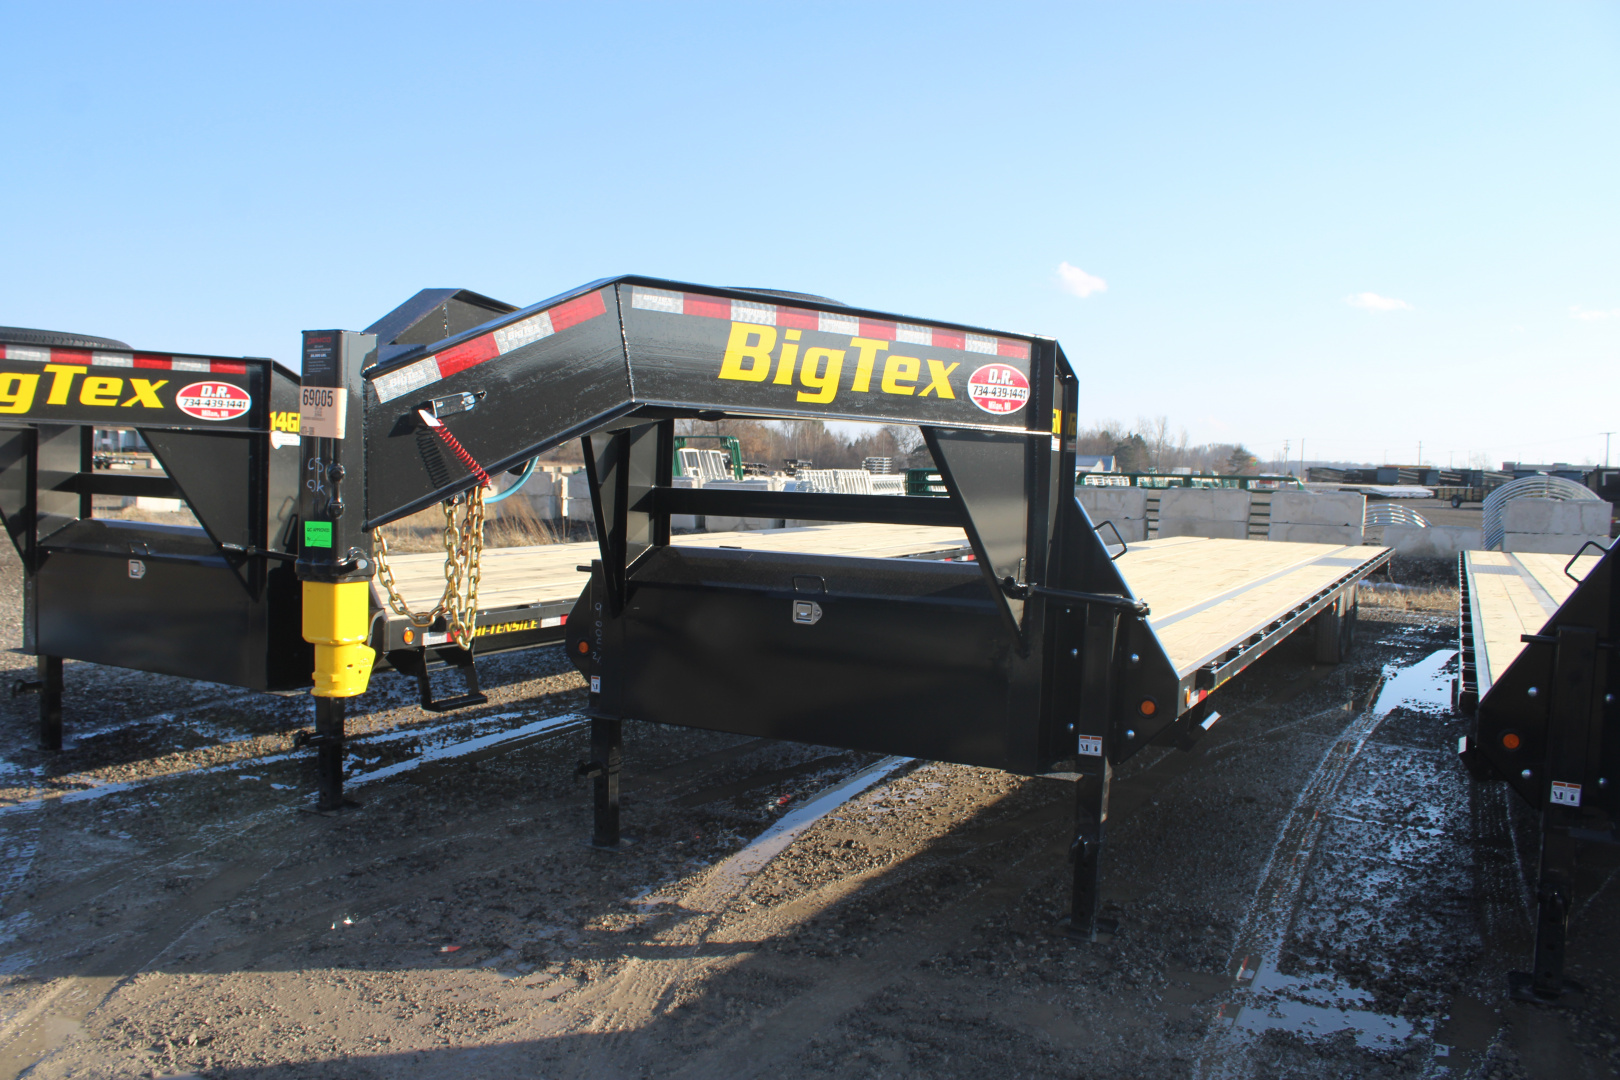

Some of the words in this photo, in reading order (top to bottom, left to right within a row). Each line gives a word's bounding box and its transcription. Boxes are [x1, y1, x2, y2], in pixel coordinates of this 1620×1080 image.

[718, 321, 961, 404] BigTex
[988, 368, 1014, 386] D.R.
[0, 364, 169, 414] gTex
[200, 385, 231, 398] D.R.
[973, 385, 1027, 400] 734-439-1441
[183, 398, 246, 409] 734-439-1441
[303, 389, 334, 407] 69005
[201, 409, 220, 418] Milan,
[269, 411, 300, 432] 14G
[473, 620, 538, 637] HI-TENSILE
